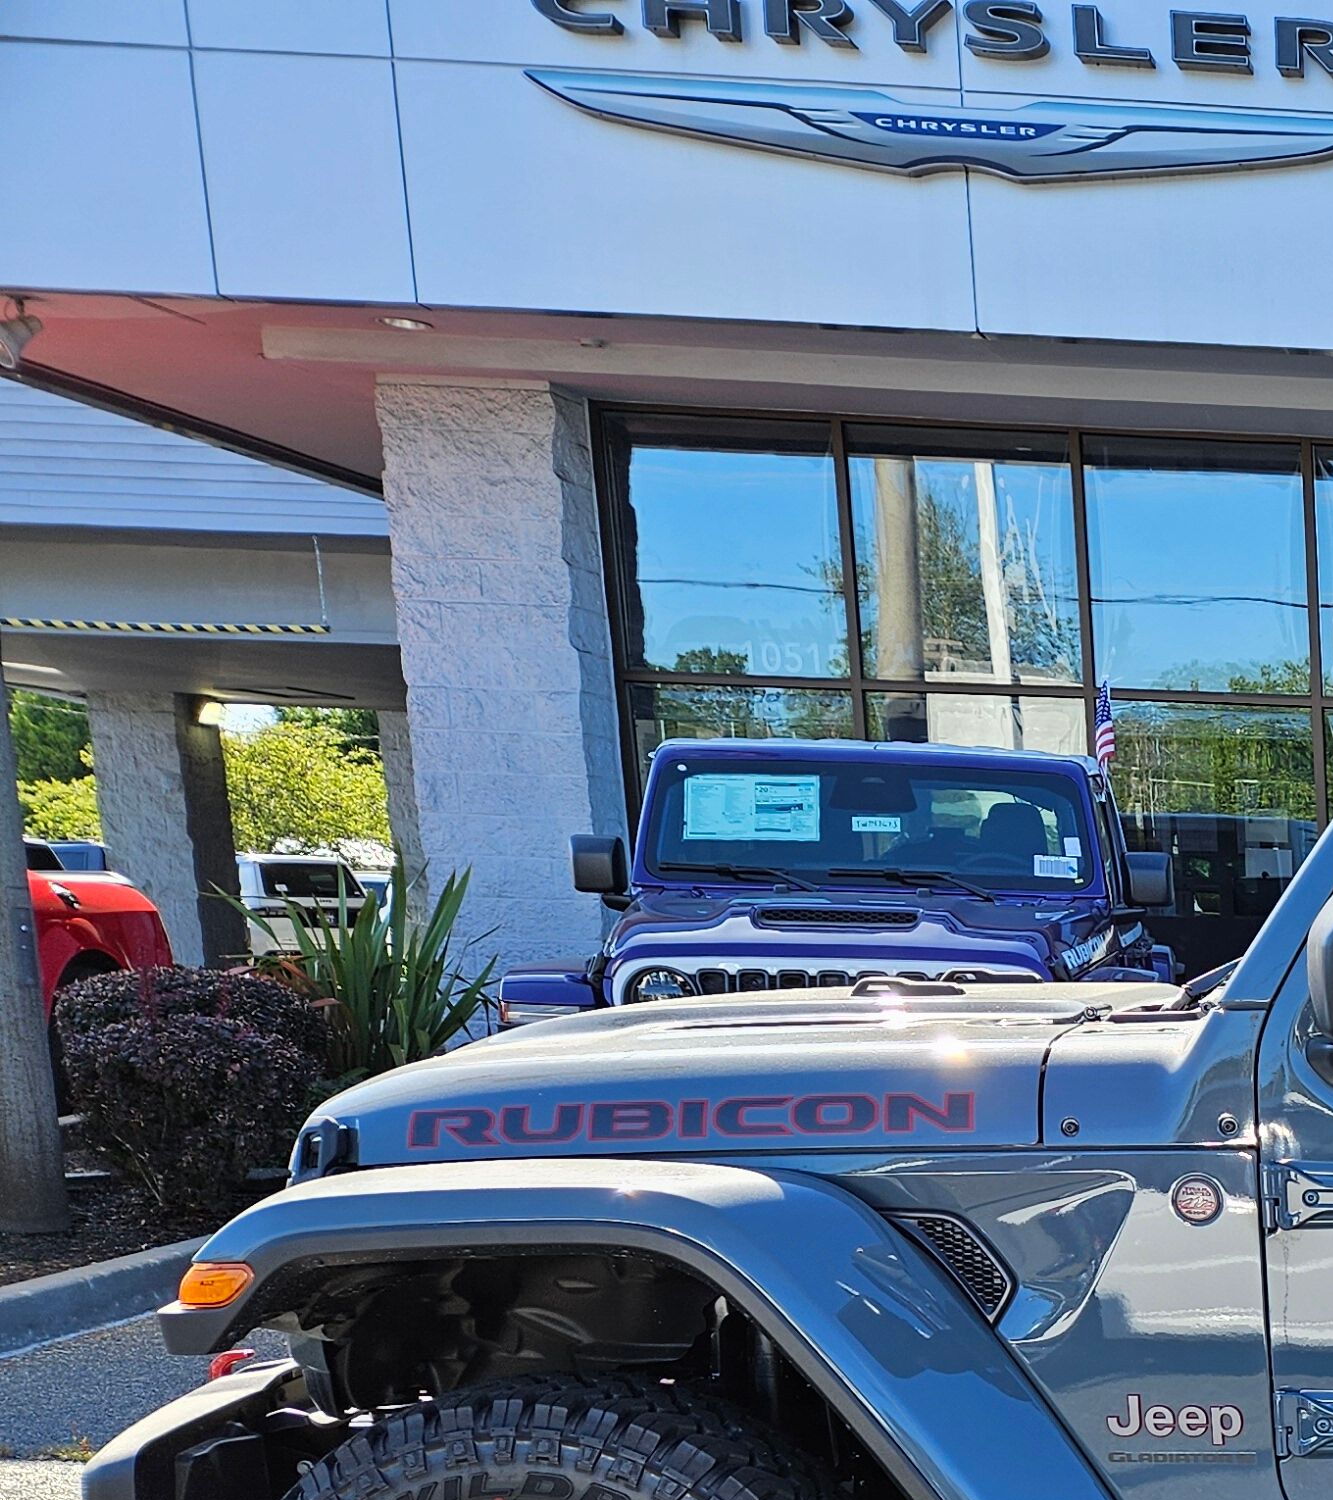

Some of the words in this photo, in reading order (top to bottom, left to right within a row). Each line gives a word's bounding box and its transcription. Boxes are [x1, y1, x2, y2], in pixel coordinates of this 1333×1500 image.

[874, 116, 1038, 138] CHRYSLER
[408, 1091, 975, 1150] RUBICON
[1106, 1394, 1244, 1446] Jeep
[1108, 1451, 1233, 1463] GLADIATOR
